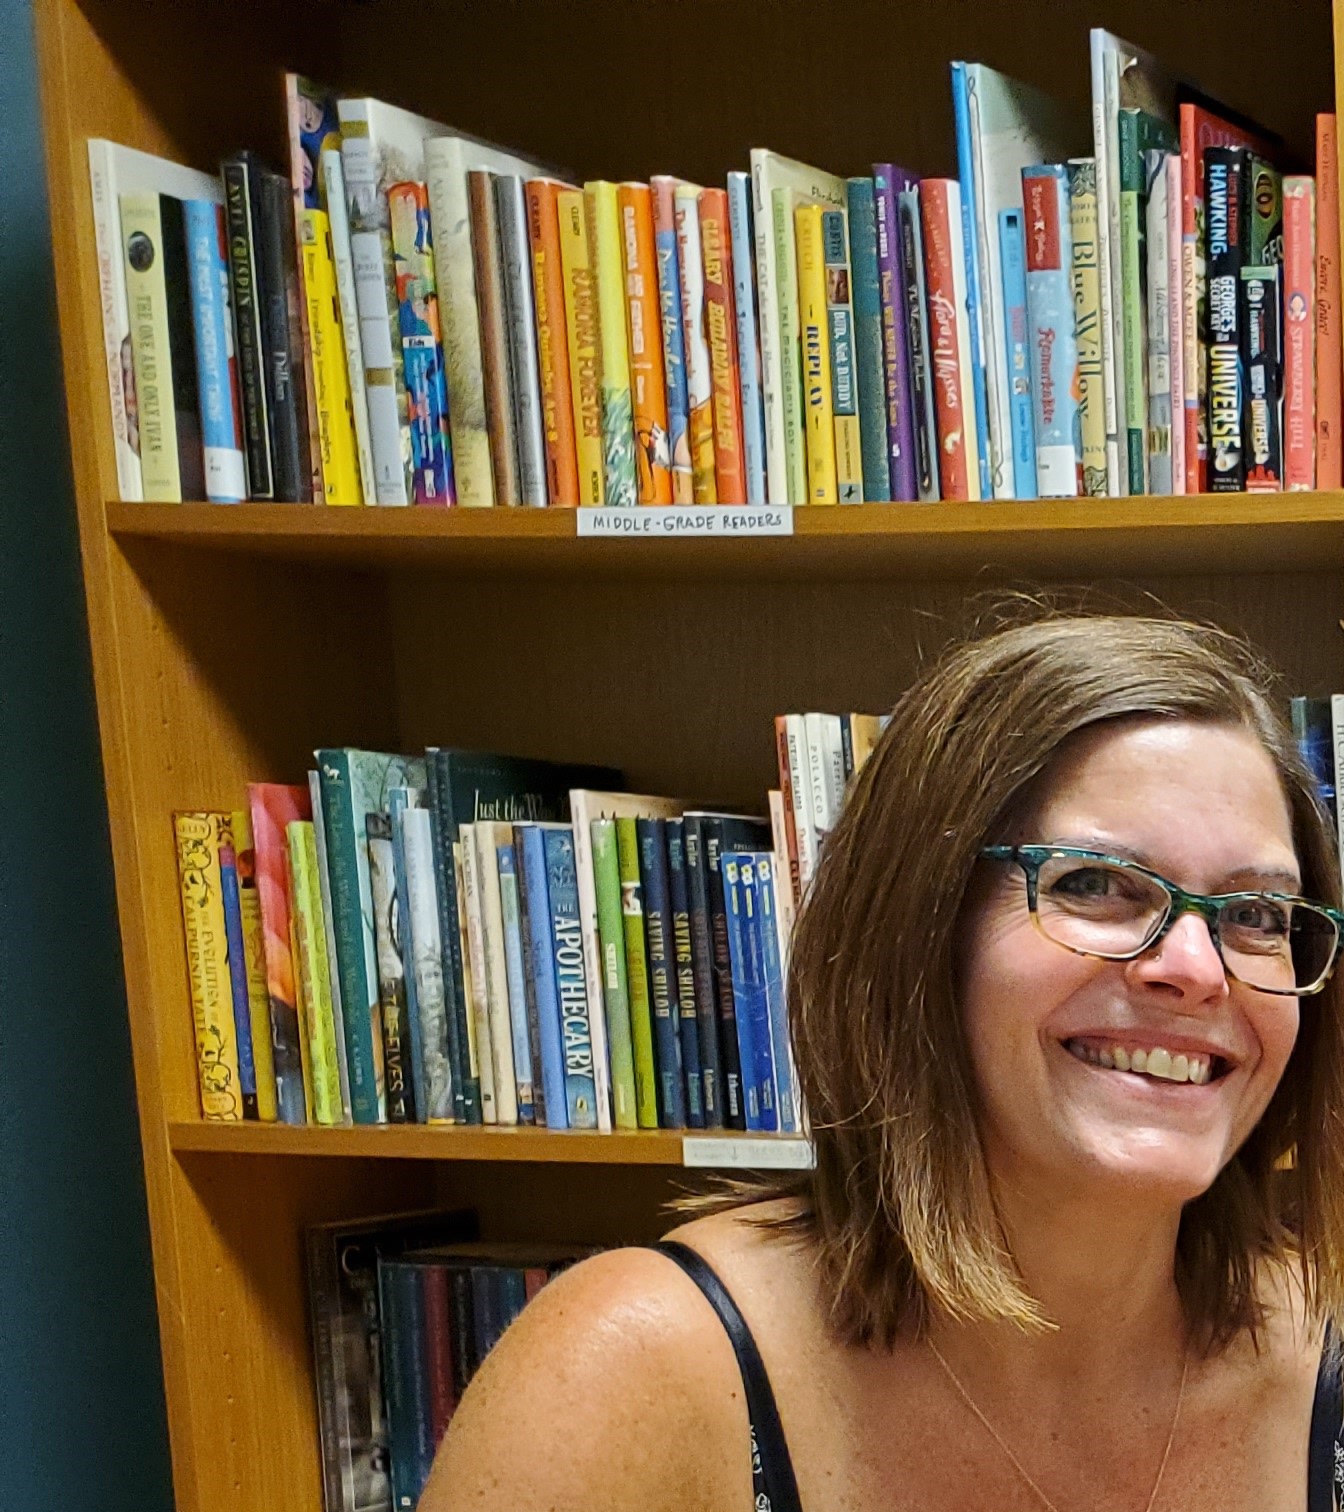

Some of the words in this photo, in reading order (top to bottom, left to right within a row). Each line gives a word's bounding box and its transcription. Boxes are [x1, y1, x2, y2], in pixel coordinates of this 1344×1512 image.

[1209, 164, 1227, 254] HAWKING
[1071, 241, 1095, 304] Blue
[136, 295, 153, 320] THE
[138, 325, 154, 352] ONE
[140, 355, 156, 381] AND
[806, 326, 822, 413] REPLAY
[1074, 311, 1102, 420] Willow
[142, 385, 159, 417] ONLY
[1210, 344, 1241, 448] UNIVERSE
[144, 421, 162, 453] IVAN
[723, 513, 782, 529] READERS
[554, 916, 592, 1079] APOTHECARY
